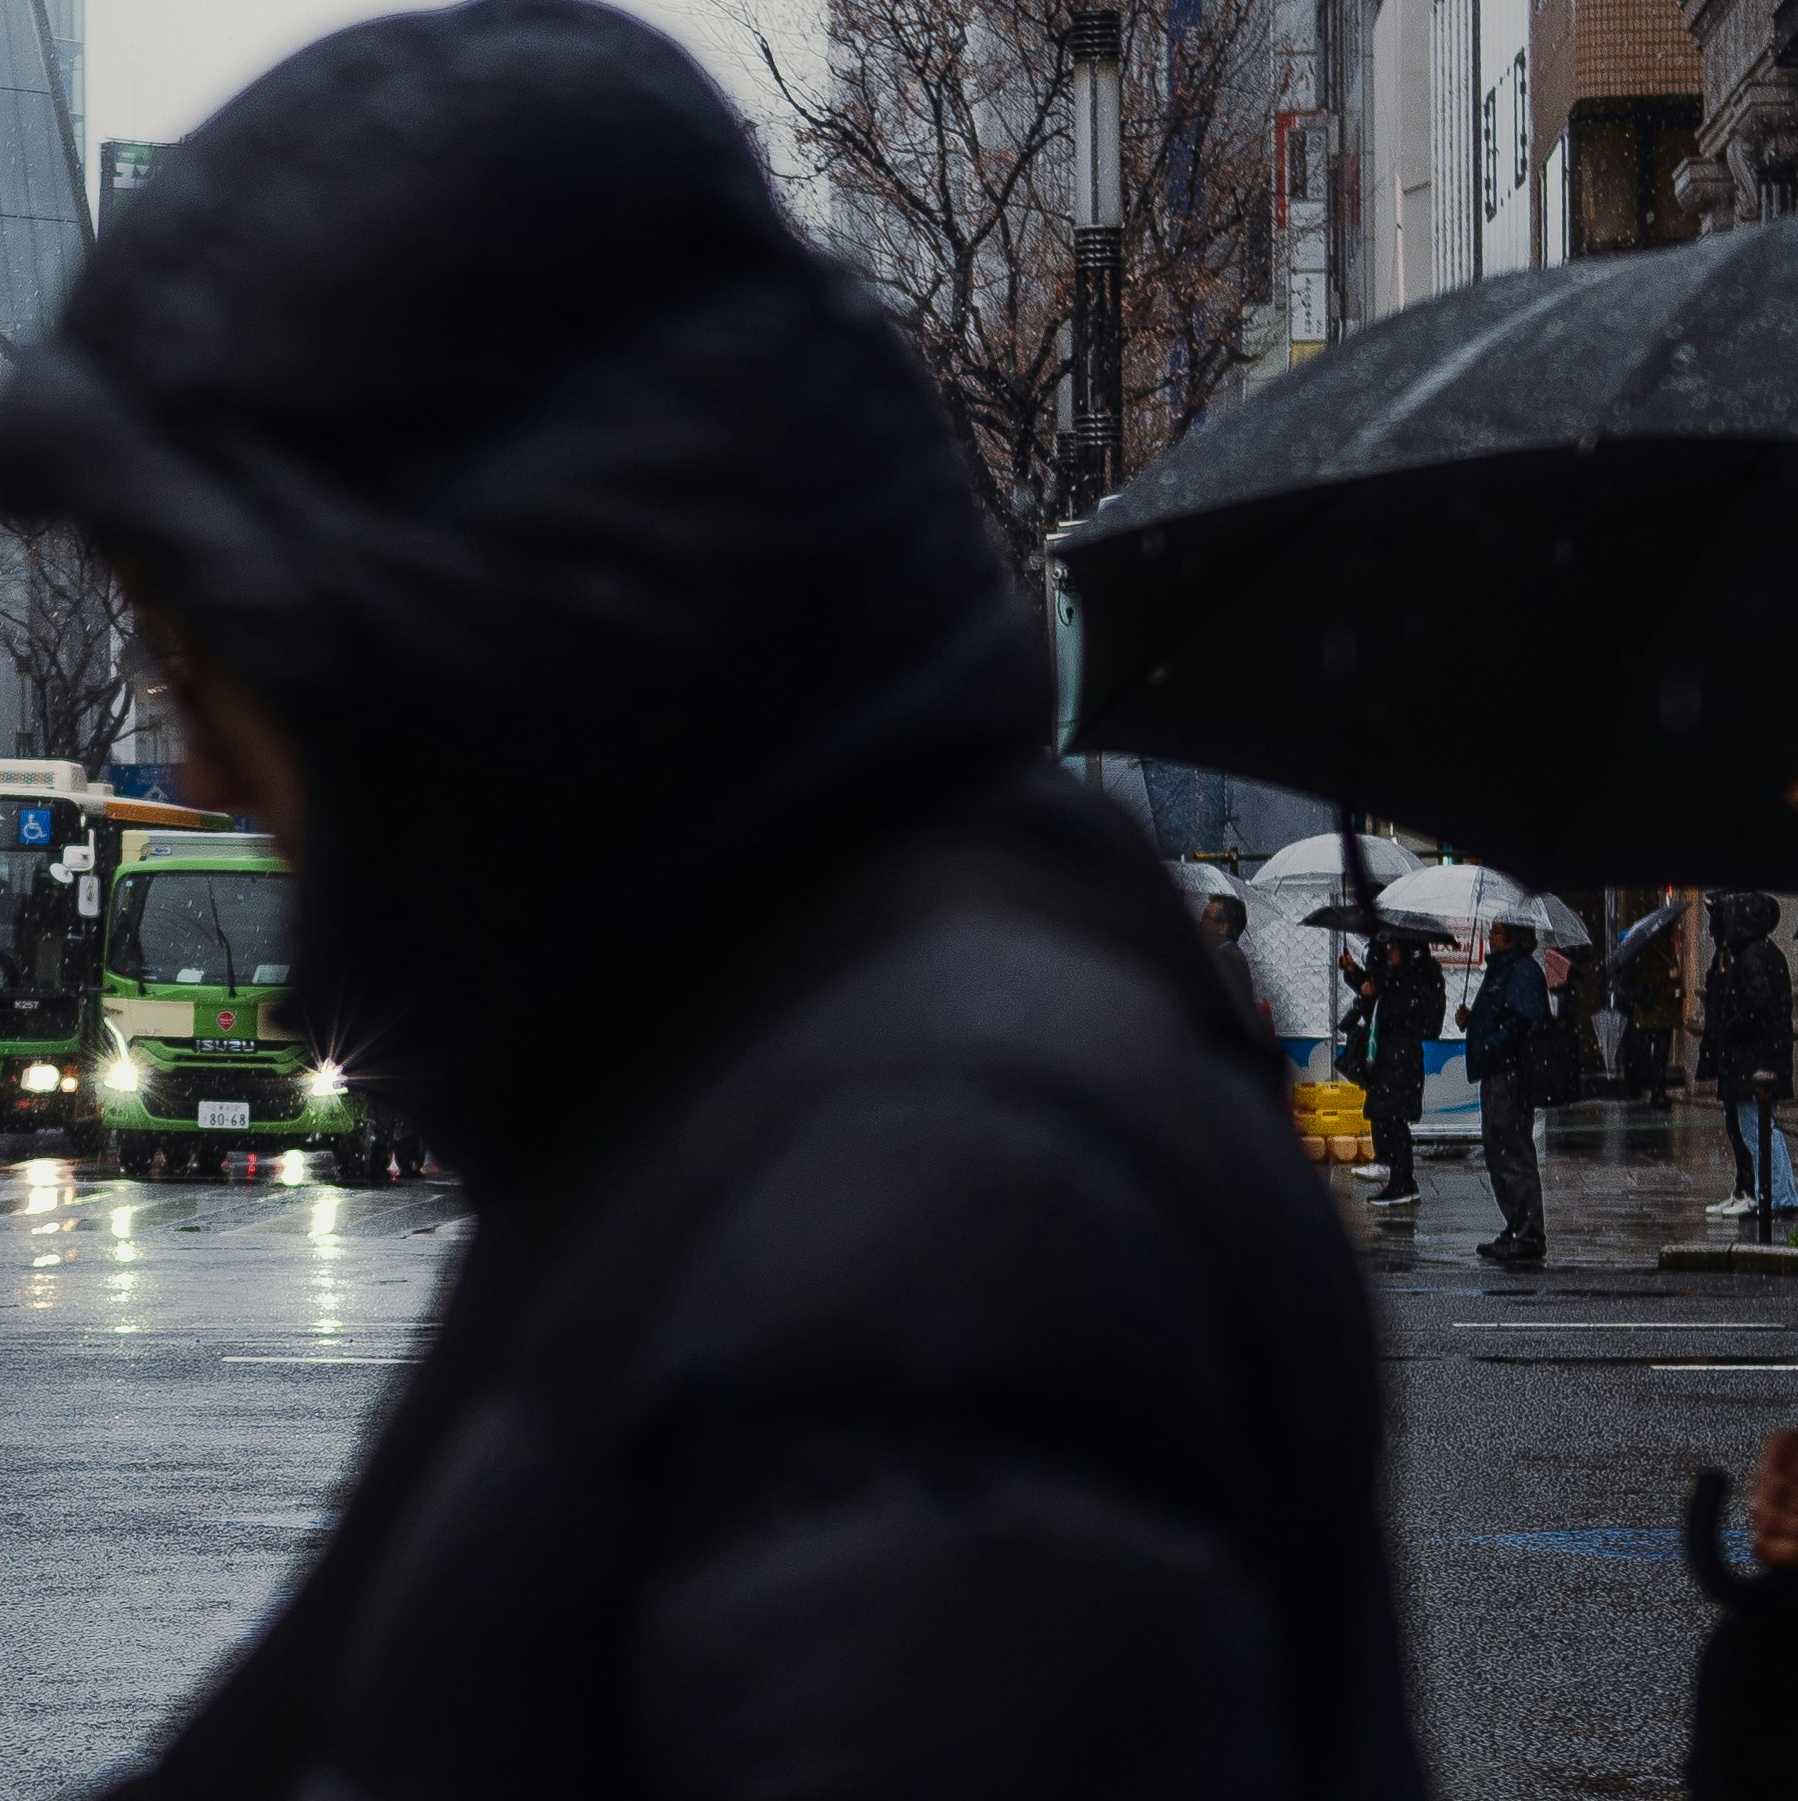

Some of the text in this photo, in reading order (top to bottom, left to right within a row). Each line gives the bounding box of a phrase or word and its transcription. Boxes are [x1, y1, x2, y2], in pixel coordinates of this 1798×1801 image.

[14, 1000, 39, 1009] K257
[195, 1039, 255, 1052] ISUZU
[209, 1113, 245, 1126] 80-68
